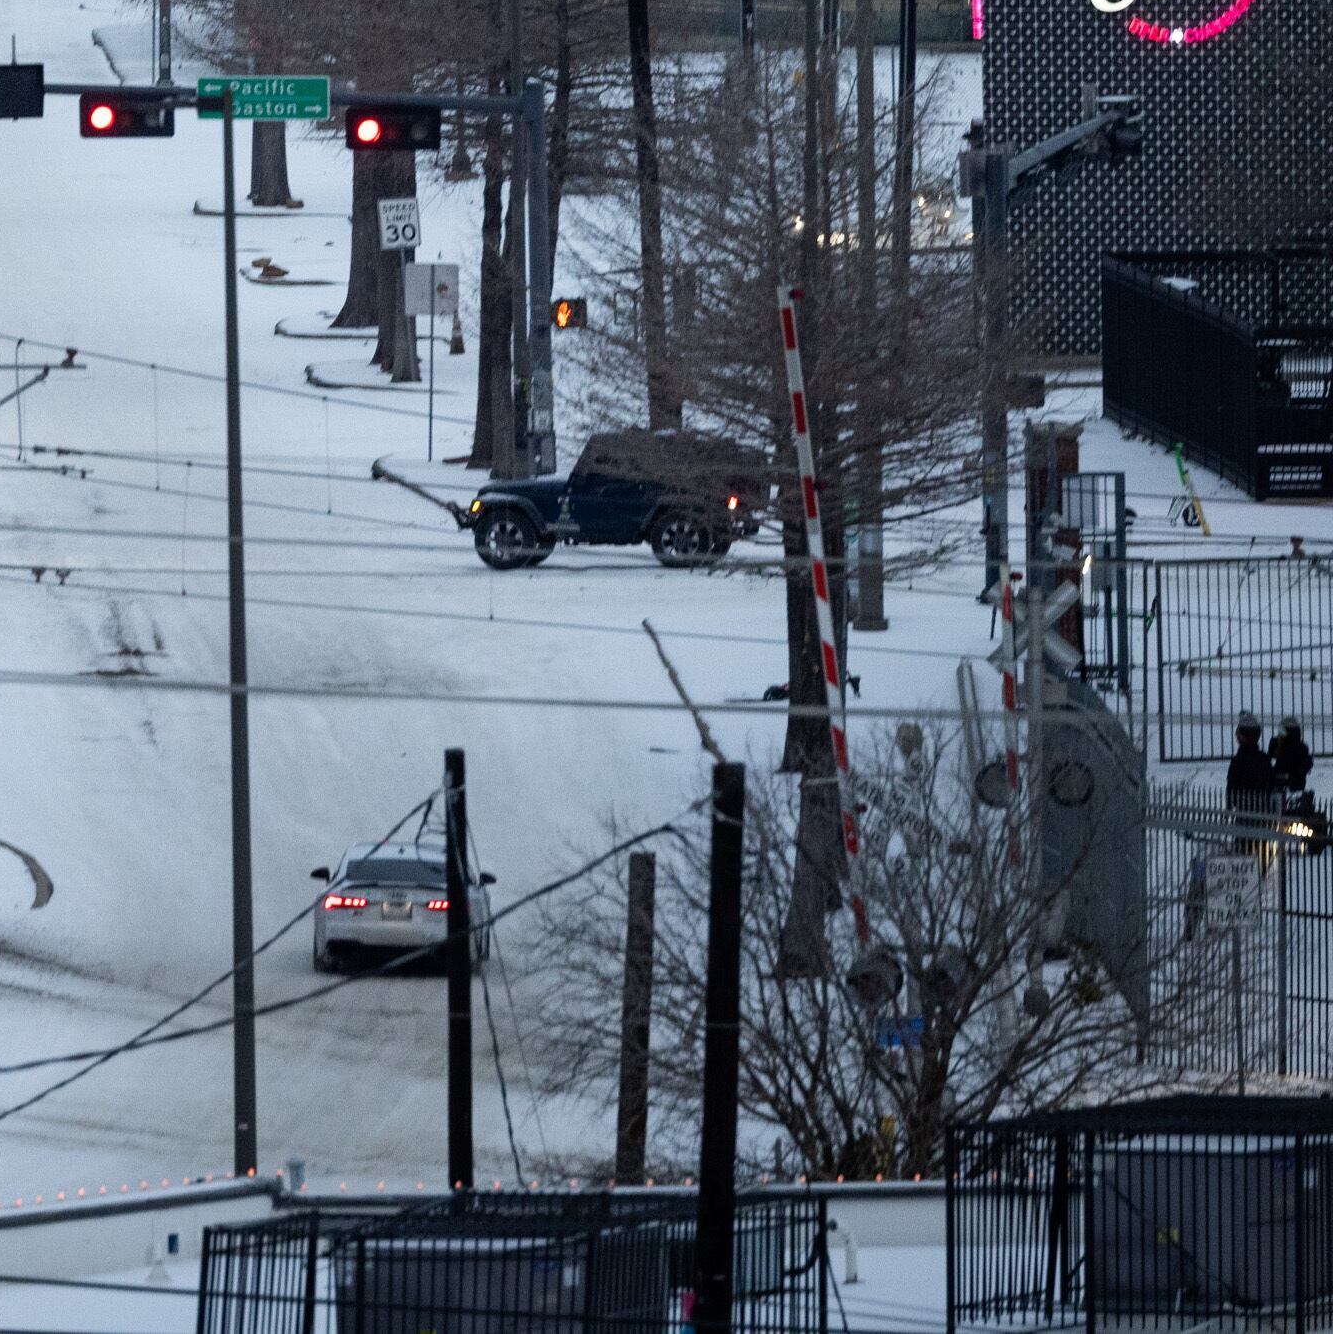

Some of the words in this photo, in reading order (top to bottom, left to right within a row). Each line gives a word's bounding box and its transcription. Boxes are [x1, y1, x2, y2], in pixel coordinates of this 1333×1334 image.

[230, 78, 296, 95] Pacific
[382, 202, 415, 214] SPEED
[386, 213, 412, 223] LIMIT
[386, 223, 416, 243] 30
